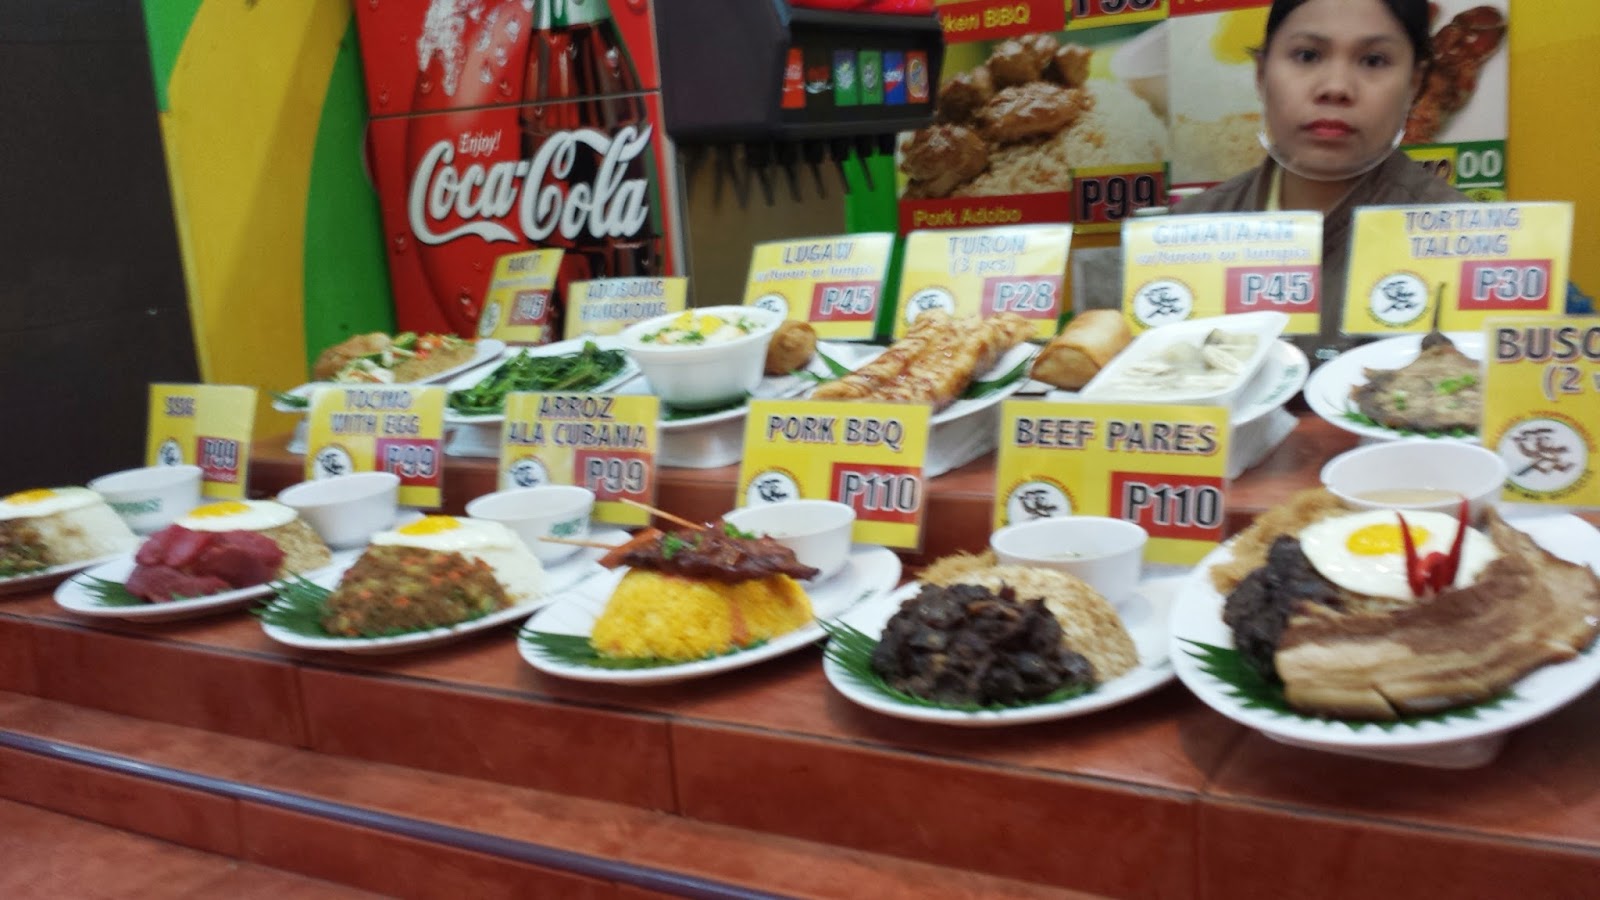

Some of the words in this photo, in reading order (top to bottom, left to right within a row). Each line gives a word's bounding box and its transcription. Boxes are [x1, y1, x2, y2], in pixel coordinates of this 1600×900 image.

[983, 5, 1030, 27] BBQ
[458, 129, 501, 155] Enjoy!
[1081, 174, 1156, 222] P99
[912, 210, 955, 226] Pork
[960, 207, 1022, 223] Adobo
[1405, 208, 1520, 231] TORTANG
[949, 235, 1025, 254] TURON
[1152, 222, 1294, 244] GINATAAN
[1411, 234, 1509, 257] TALONG
[784, 242, 853, 264] LUGAW
[993, 281, 1055, 311] P28
[1241, 272, 1315, 305] P45
[1473, 267, 1547, 301] P30
[820, 286, 874, 315] P45
[345, 390, 412, 409] TOCINO
[539, 395, 614, 420] ARROZ
[332, 413, 377, 434] WITH
[383, 414, 420, 435] EGG
[553, 423, 648, 447] CUBANA
[766, 414, 837, 445] PORK
[844, 417, 904, 452] BBQ
[1014, 417, 1097, 449] BEEF
[1107, 420, 1221, 456] PARES
[202, 440, 239, 470] P99
[384, 444, 438, 478] P99
[584, 456, 648, 494] P99
[838, 469, 923, 513] P110
[1122, 480, 1226, 530] P110
